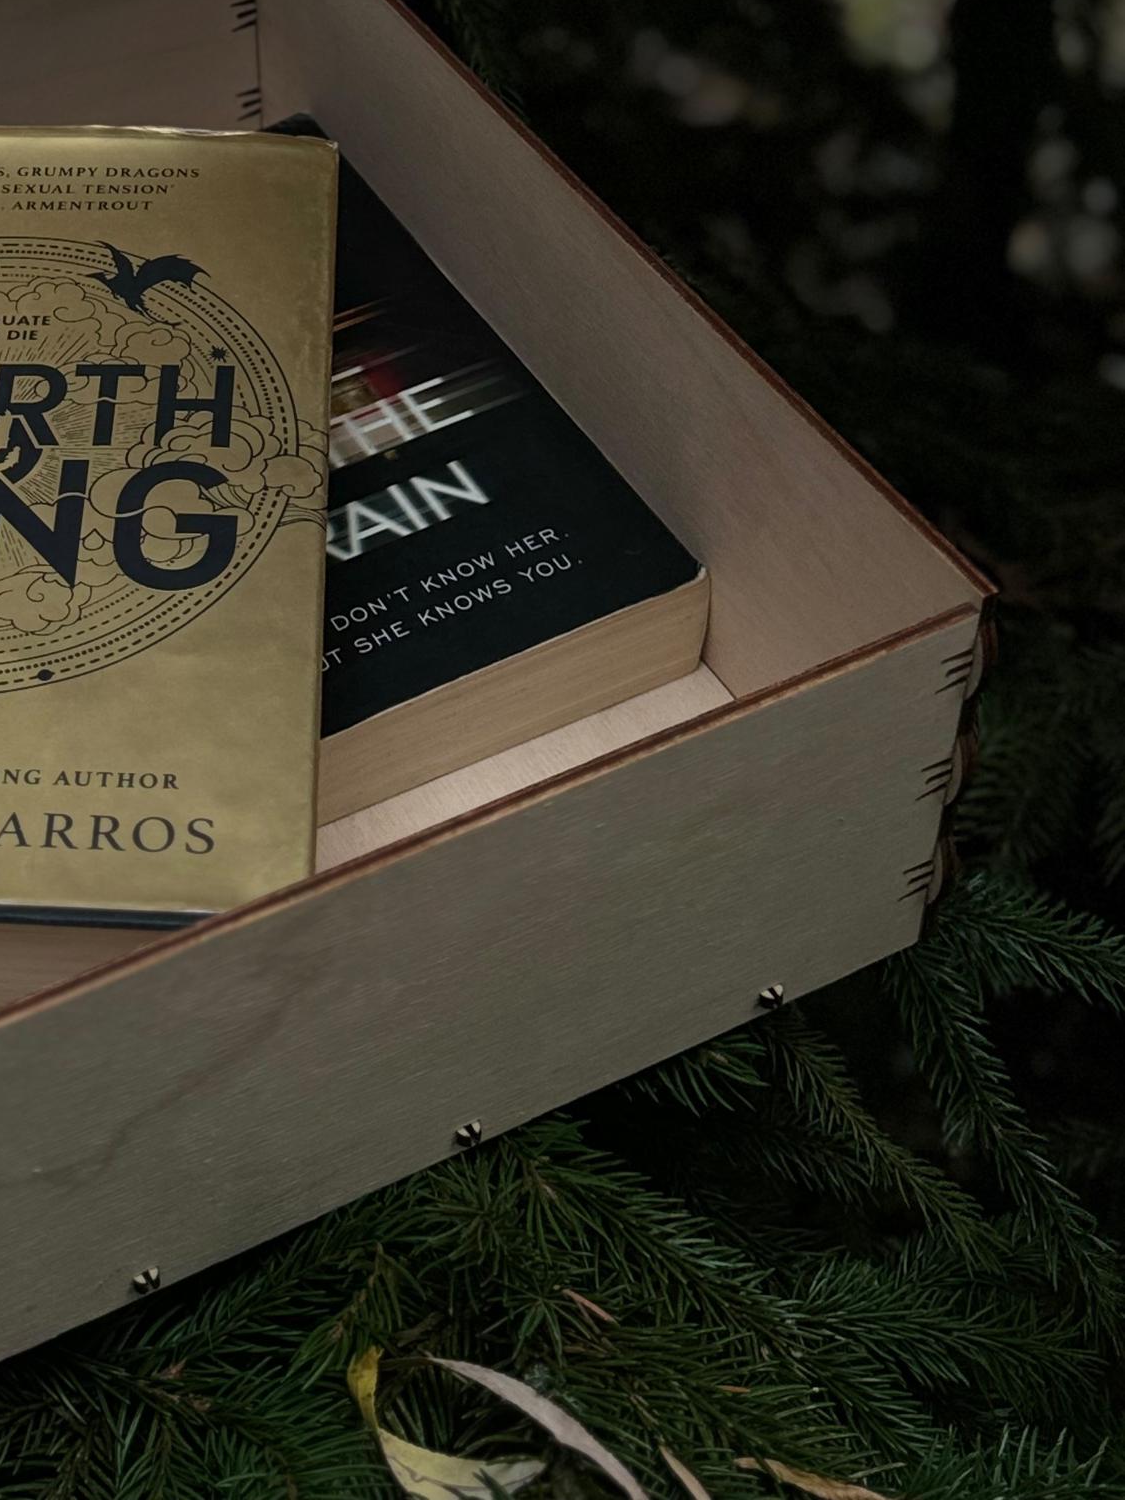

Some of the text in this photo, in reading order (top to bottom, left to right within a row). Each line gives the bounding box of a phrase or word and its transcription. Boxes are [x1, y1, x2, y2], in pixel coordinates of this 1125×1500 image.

[17, 167, 98, 177] GRUMPY
[105, 168, 201, 179] DRAGONS
[1, 184, 76, 195] SEXUAL
[11, 201, 154, 211] ARMENTROUT
[6, 329, 39, 341] DIE
[330, 527, 571, 633] DON'T KNOW HER.
[353, 620, 411, 655] SHE
[417, 578, 513, 628] KNOWS
[517, 553, 585, 584] YOU.
[52, 770, 180, 790] AUTHOR
